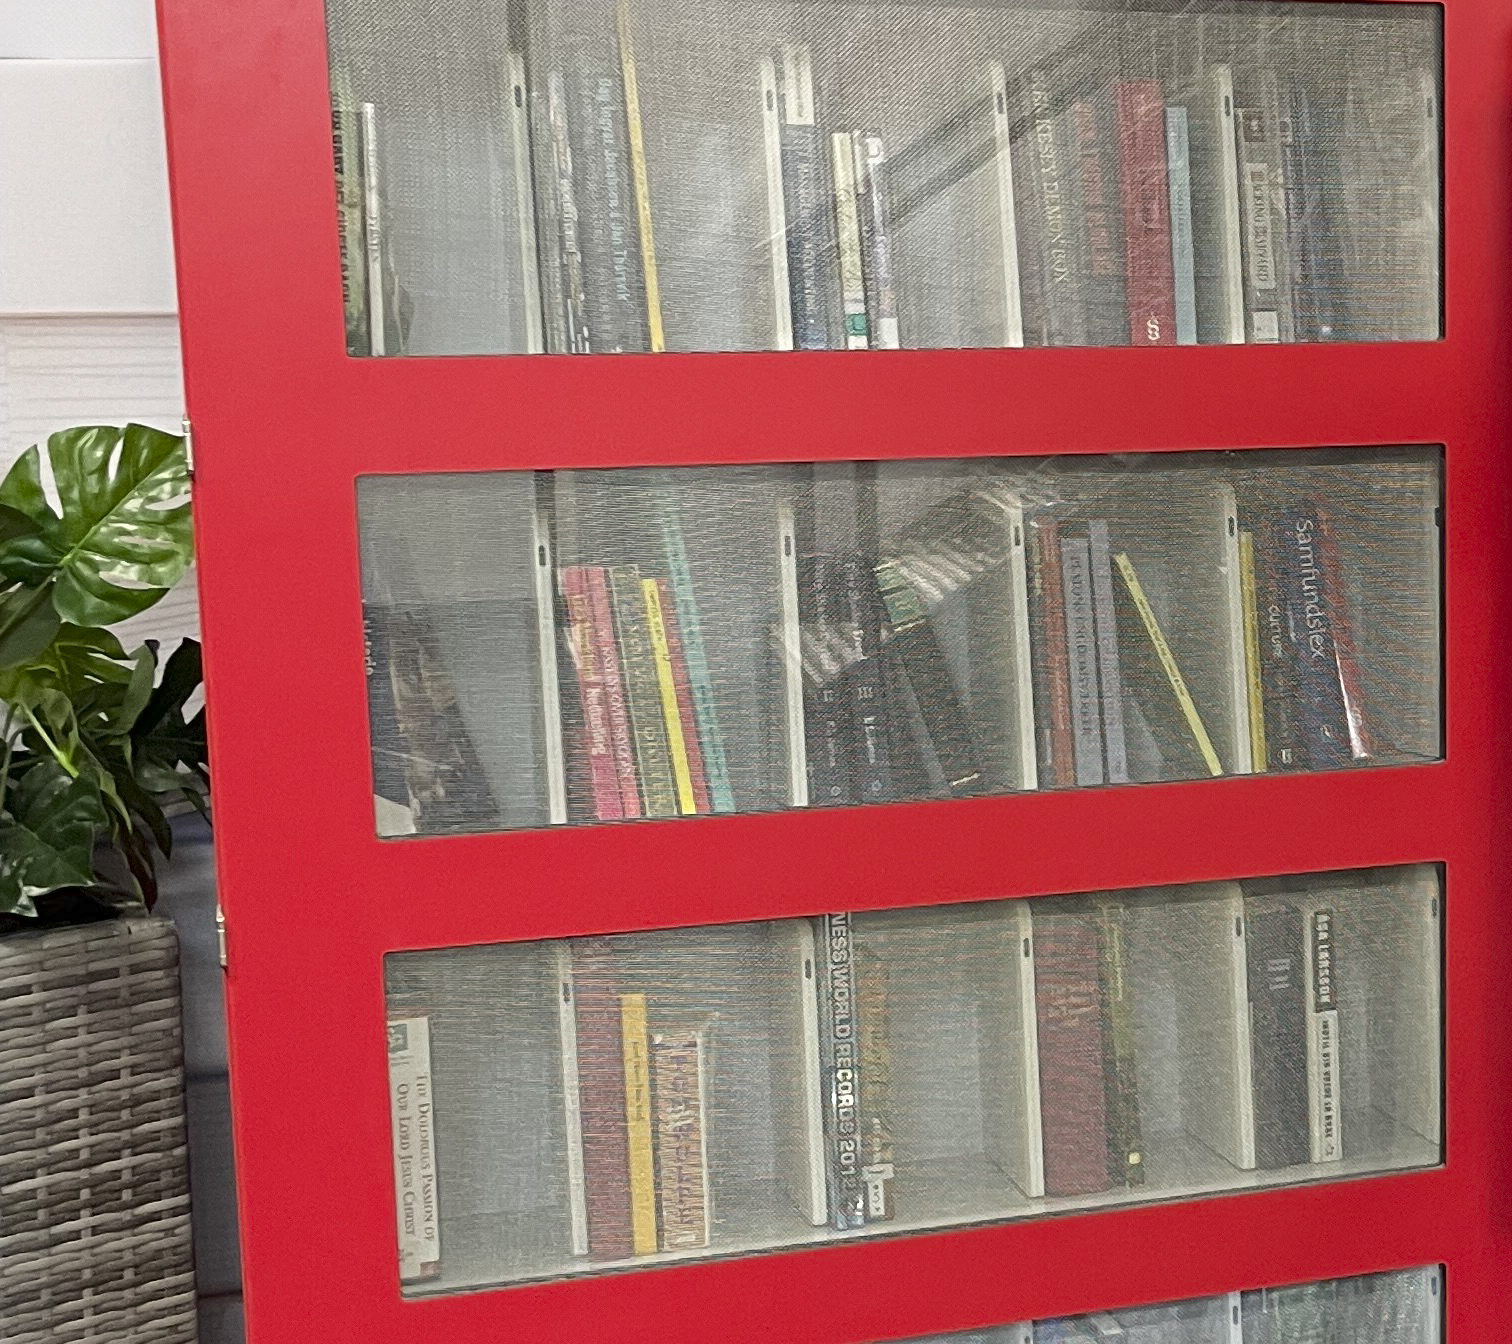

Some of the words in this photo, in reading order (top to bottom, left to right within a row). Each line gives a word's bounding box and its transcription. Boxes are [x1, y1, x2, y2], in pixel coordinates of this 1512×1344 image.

[1295, 519, 1330, 659] Samfundslex
[1315, 943, 1332, 1003] LARSSON
[828, 967, 854, 1038] WORLD
[394, 1083, 411, 1112] OUR
[832, 1043, 859, 1135] RECORDS
[396, 1116, 412, 1151] LORD
[397, 1153, 415, 1188] JESUS
[401, 1190, 418, 1236] CHRIST
[418, 1173, 437, 1222] PASSION
